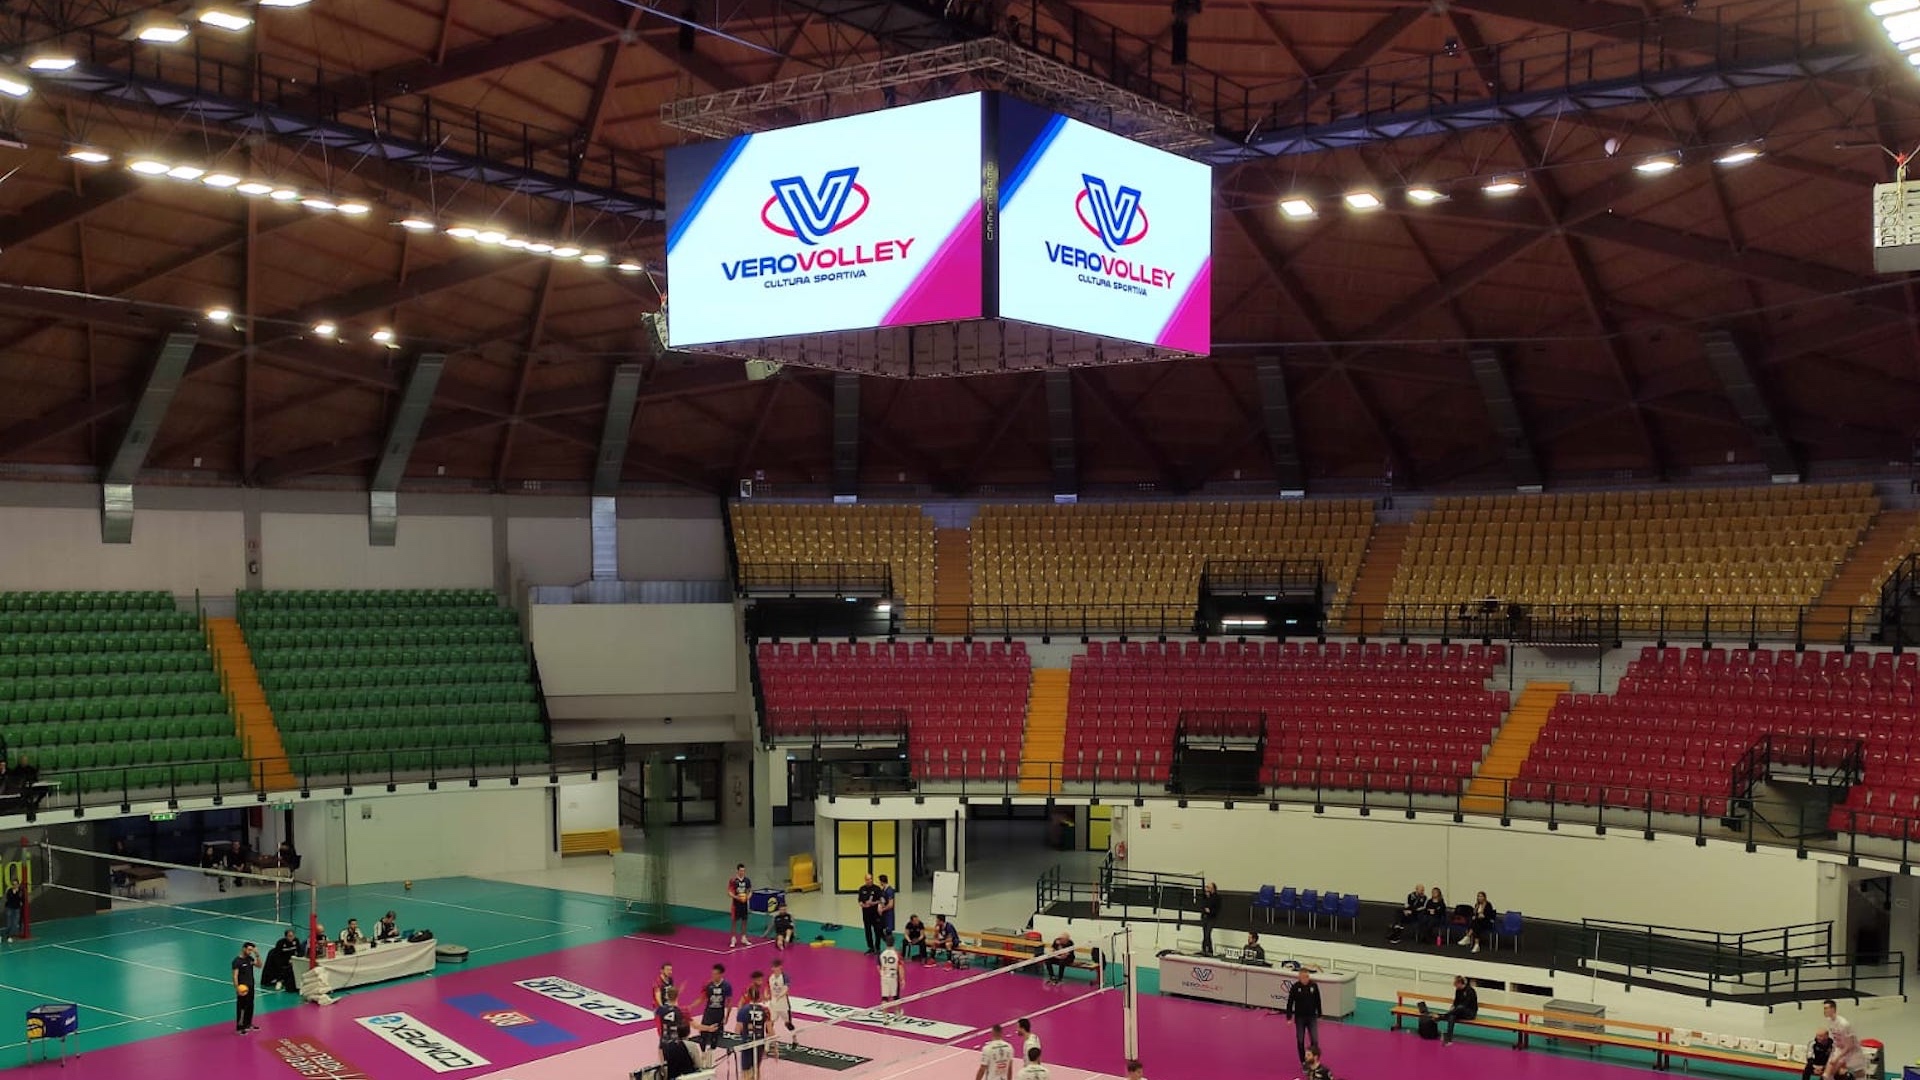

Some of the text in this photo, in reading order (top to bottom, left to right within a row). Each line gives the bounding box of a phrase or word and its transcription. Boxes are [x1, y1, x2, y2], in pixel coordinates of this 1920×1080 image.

[764, 269, 867, 288] CULTURA SPORTIVA
[1078, 274, 1147, 296] CULTURA SPORTIVA
[883, 956, 896, 964] 10
[663, 1012, 675, 1022] 4
[749, 1011, 763, 1021] 13
[383, 1023, 473, 1068] COMPEX
